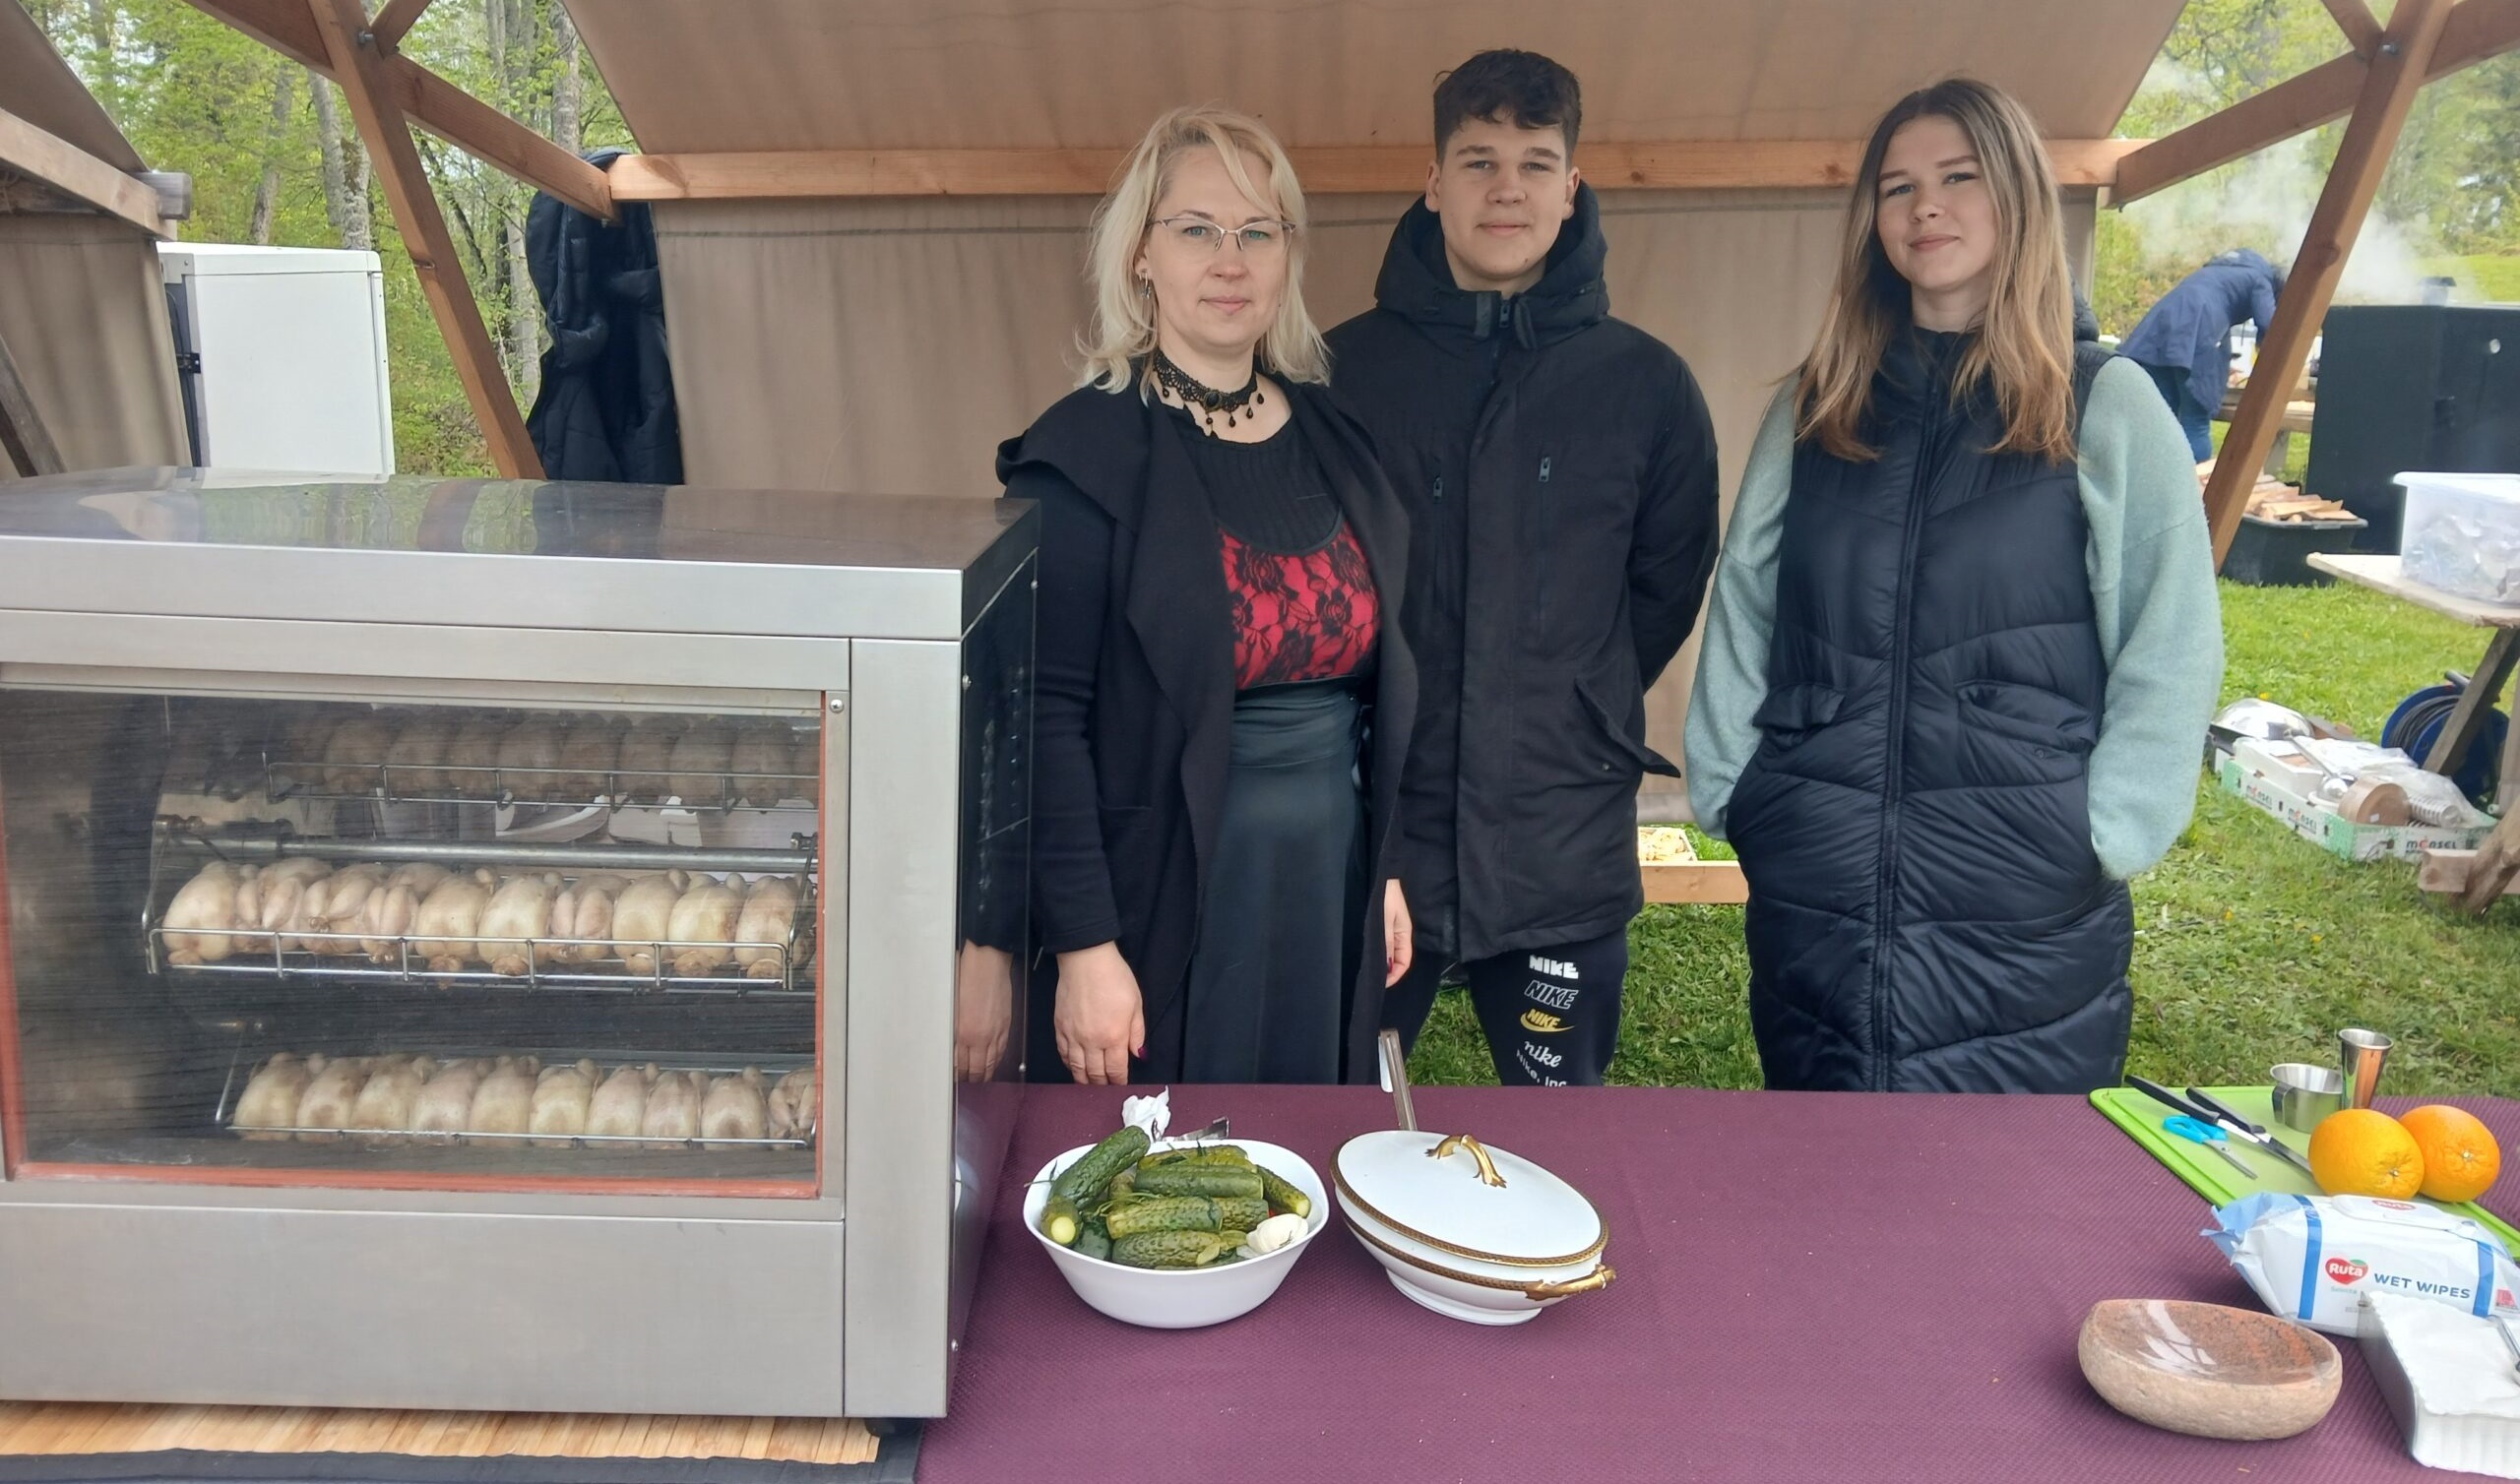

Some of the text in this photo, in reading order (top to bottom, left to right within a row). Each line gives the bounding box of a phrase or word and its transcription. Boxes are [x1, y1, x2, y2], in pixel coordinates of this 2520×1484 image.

[1529, 955, 1579, 979] NIKE
[1524, 979, 1579, 1010] NIKE
[1527, 1008, 1561, 1028] NIKE
[1524, 1040, 1562, 1068] nike
[2328, 1263, 2363, 1276] Ruta
[2373, 1272, 2471, 1299] WET WIPES
